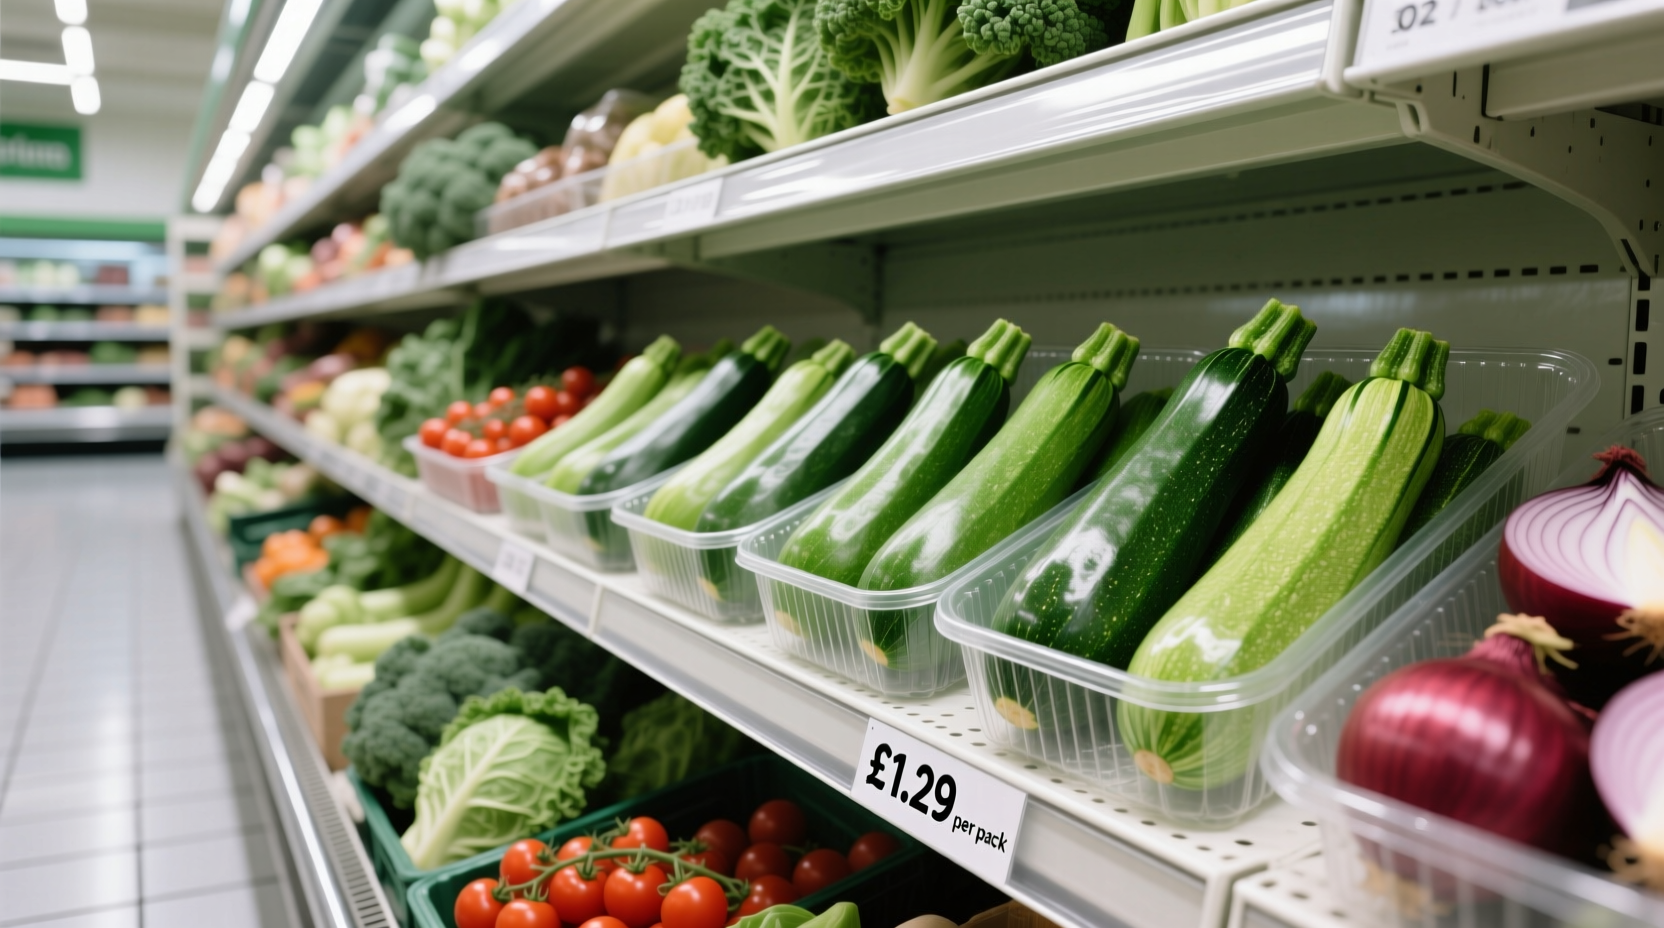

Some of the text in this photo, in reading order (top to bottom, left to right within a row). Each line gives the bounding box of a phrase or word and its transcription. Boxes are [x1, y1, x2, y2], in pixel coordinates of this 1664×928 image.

[866, 743, 1007, 853] £1.29 per pack
